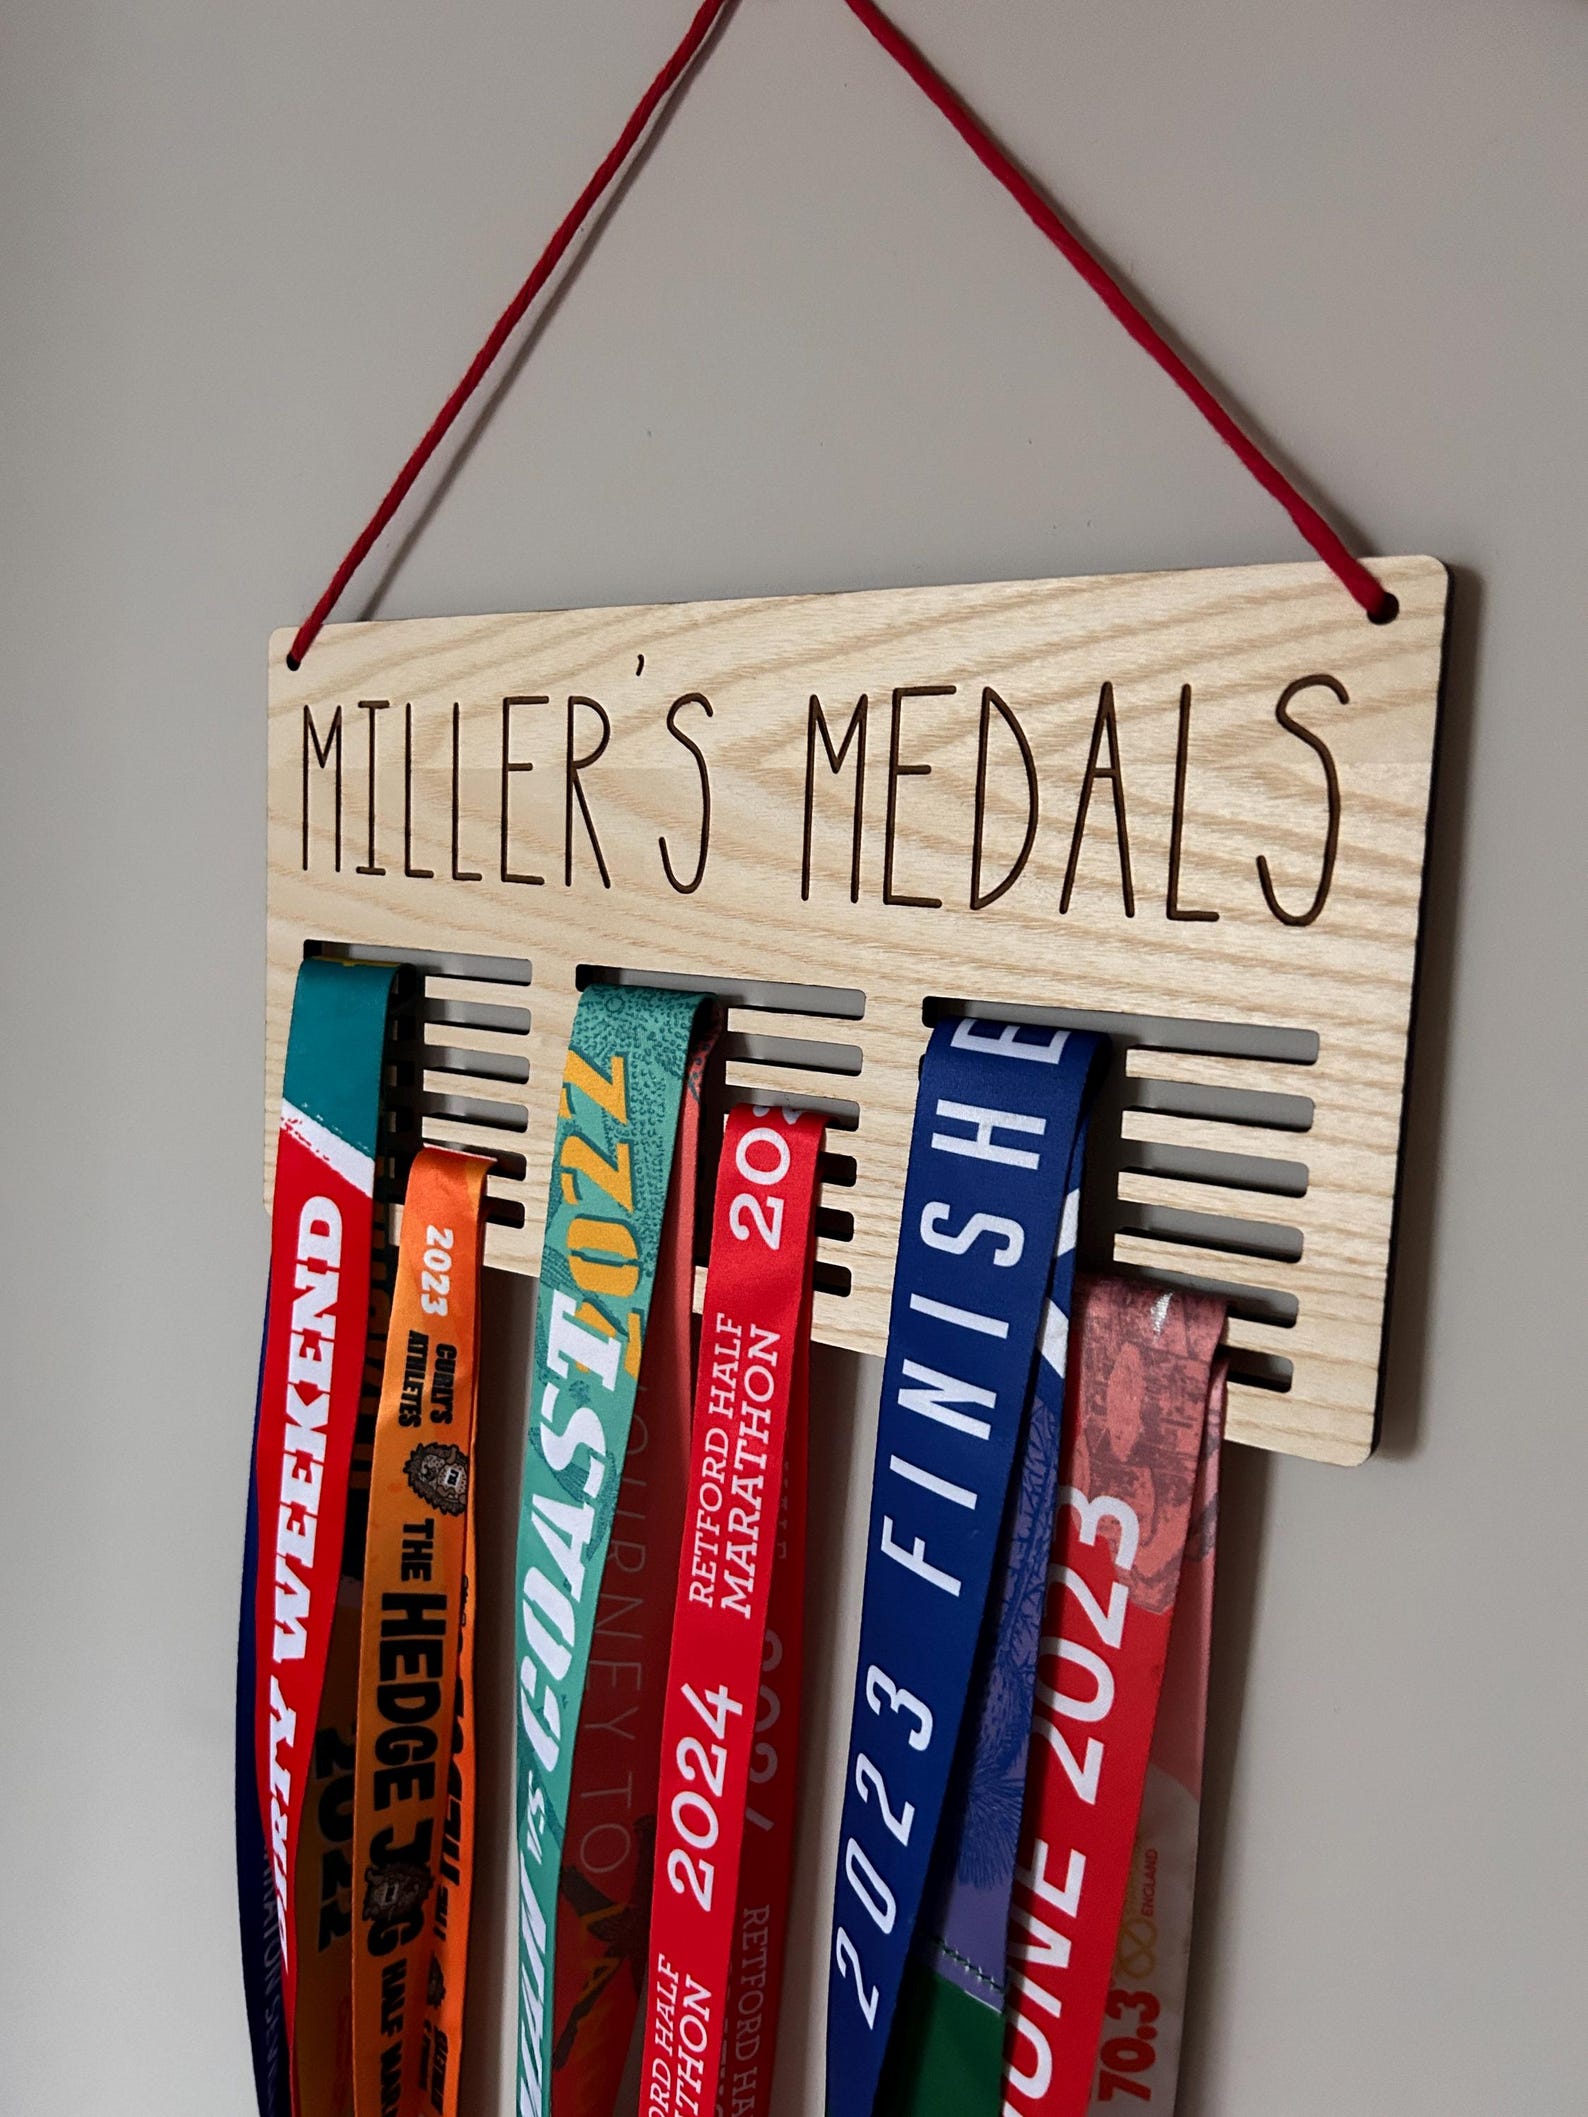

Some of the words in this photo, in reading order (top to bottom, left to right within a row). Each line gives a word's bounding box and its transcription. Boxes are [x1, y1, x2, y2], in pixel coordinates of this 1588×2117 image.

[302, 653, 713, 894] MILLER'S
[800, 674, 1350, 927] MEDALS
[398, 1329, 429, 1428] ATHLETES
[421, 1225, 454, 1317] 2023
[708, 1313, 742, 1419] HALF
[272, 1196, 342, 1663] WEEKEND
[430, 1343, 457, 1425] CURLY'S
[721, 1324, 781, 1620] MARATHON
[401, 1518, 434, 1582] THE
[520, 1289, 621, 1772] COAST
[689, 1427, 729, 1608] RETFORD
[373, 1593, 447, 1812] HEDGE
[1032, 1485, 1140, 1806] 2023
[269, 1675, 296, 1974] DIRTY
[580, 1770, 632, 1874] TO
[667, 1682, 743, 1912] 2024
[836, 1664, 933, 2030] 2023
[655, 1953, 680, 2057] HALF
[734, 1904, 770, 2061] RETFORD
[1103, 1990, 1160, 2102] 70.3
[1142, 1848, 1158, 1918] ENGLAND
